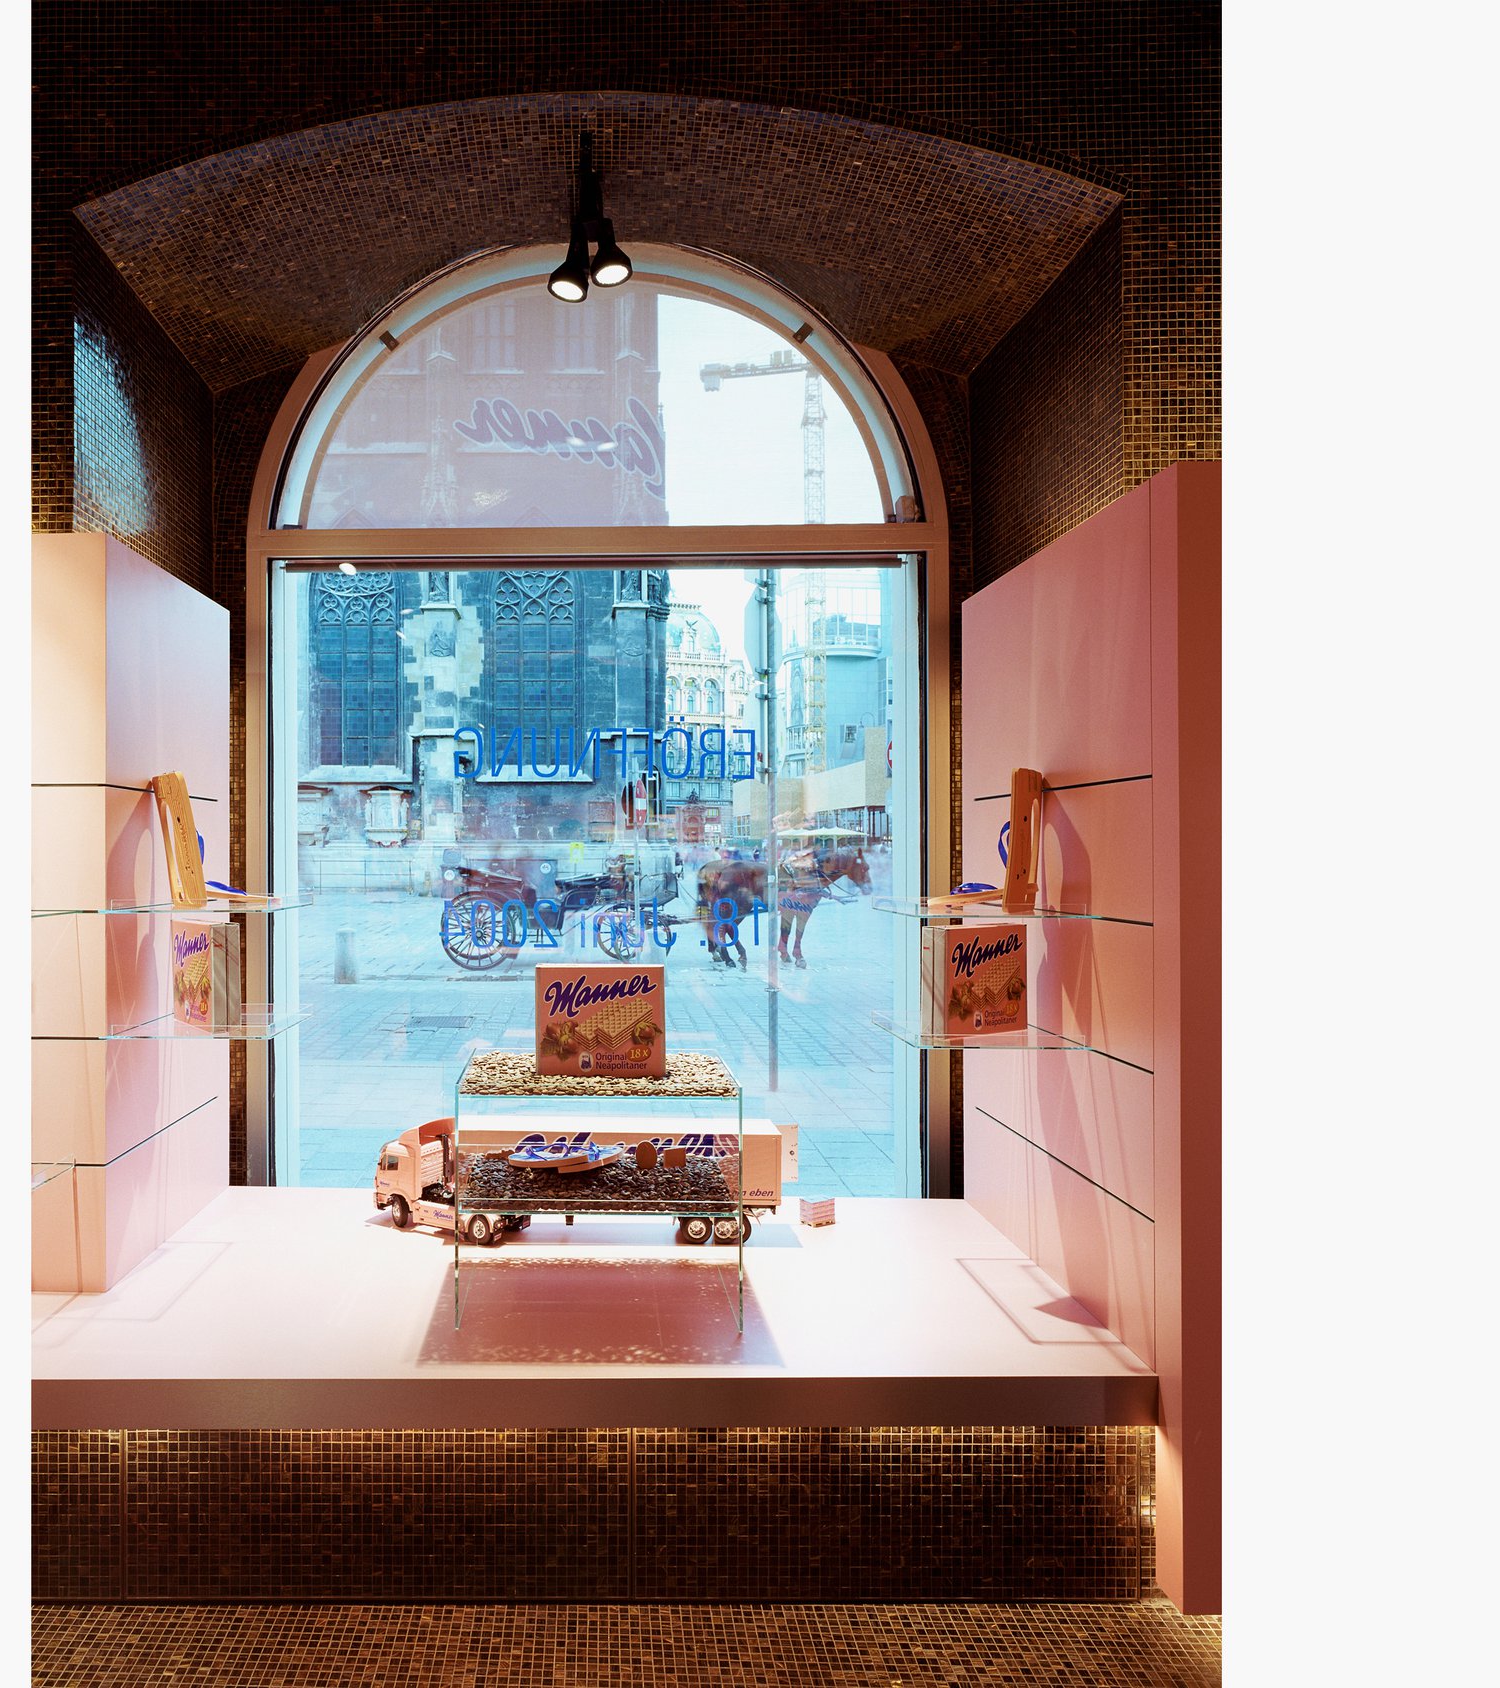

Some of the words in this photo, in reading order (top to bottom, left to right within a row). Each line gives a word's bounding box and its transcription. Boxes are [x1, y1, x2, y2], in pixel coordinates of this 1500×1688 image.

[174, 932, 209, 966] Manner
[952, 932, 1023, 978] Manner
[544, 974, 658, 1017] Manner
[595, 1052, 627, 1062] Original
[595, 1061, 647, 1071] Neapolitaner
[749, 1189, 773, 1197] eben
